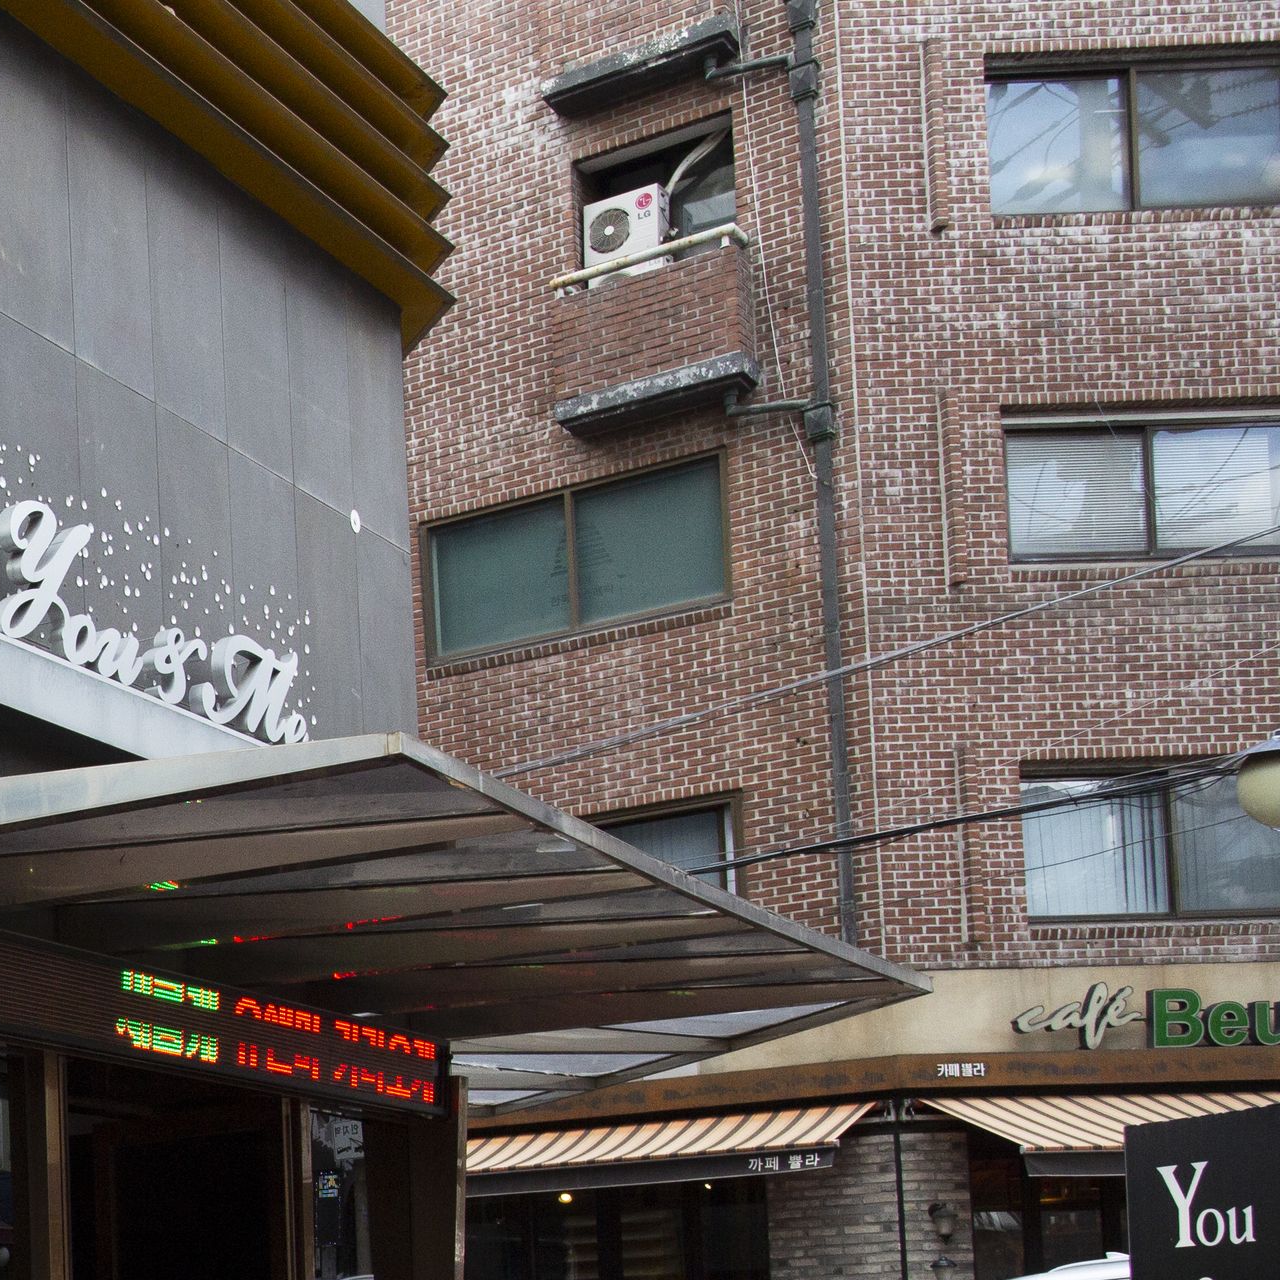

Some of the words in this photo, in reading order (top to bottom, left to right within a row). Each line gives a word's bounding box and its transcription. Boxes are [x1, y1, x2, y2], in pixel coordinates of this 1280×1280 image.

[637, 210, 652, 220] LG
[144, 627, 208, 705] &
[189, 634, 307, 743] Me
[936, 1063, 960, 1078] 카페
[1156, 1160, 1257, 1249] You
